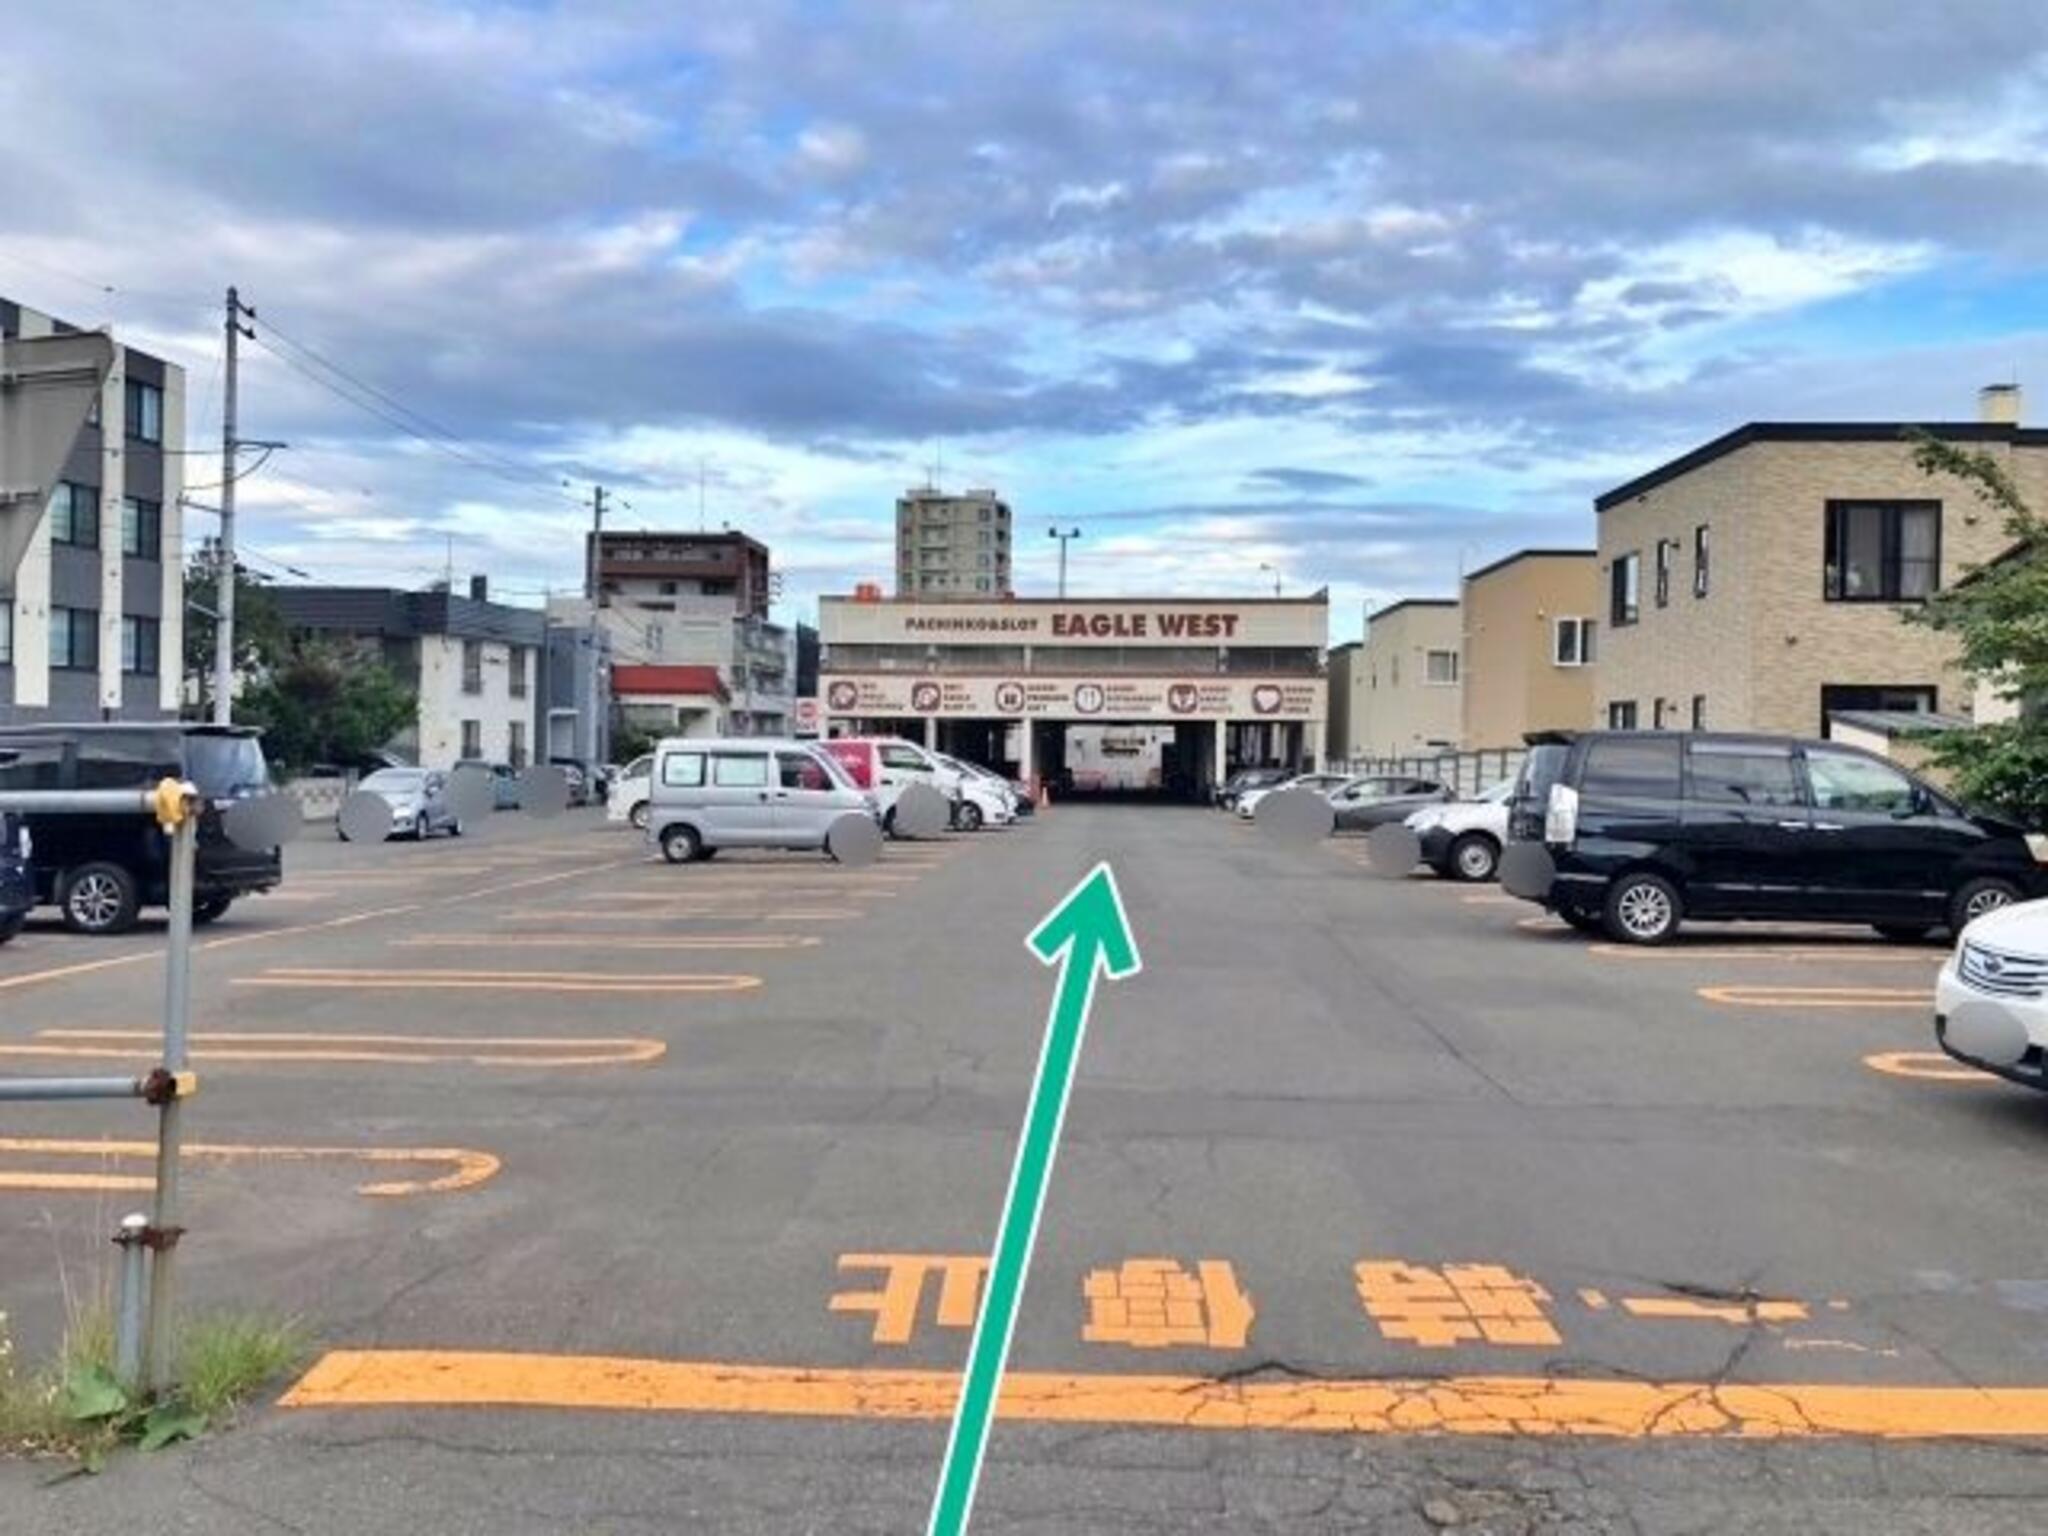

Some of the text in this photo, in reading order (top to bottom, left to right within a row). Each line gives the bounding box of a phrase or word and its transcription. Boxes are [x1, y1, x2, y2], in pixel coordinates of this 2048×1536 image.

[905, 614, 1238, 636] PACHINKO&SLOT EAGLE WEST
